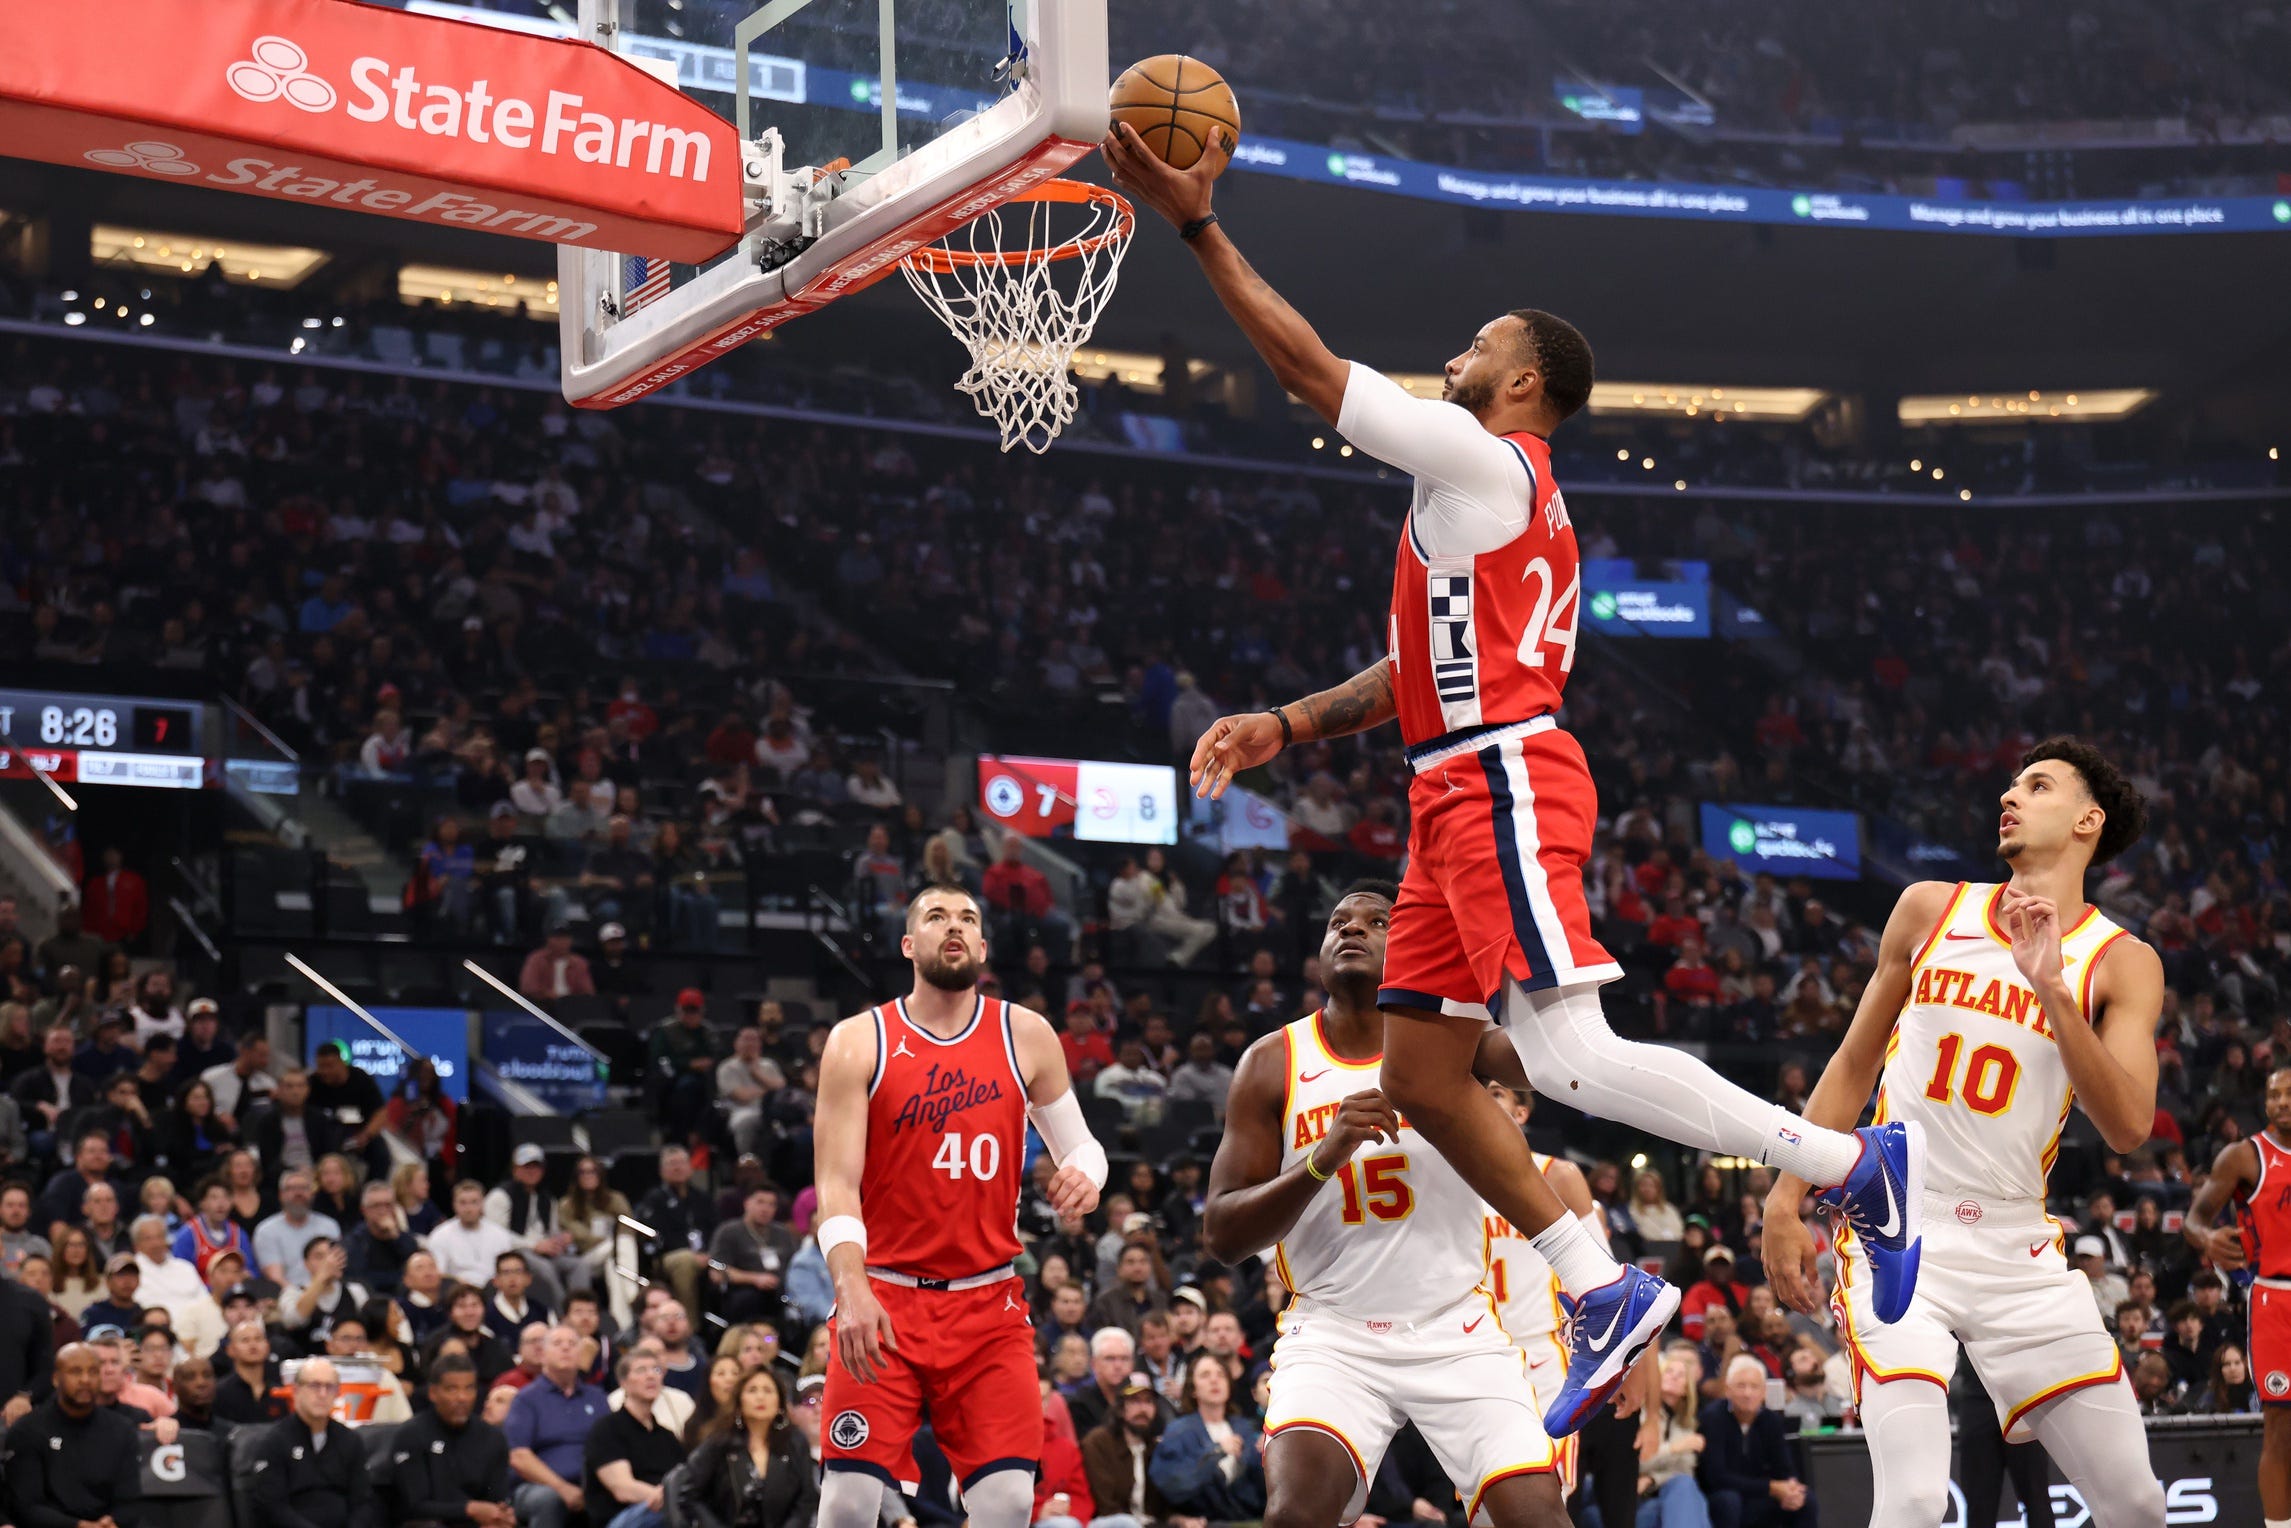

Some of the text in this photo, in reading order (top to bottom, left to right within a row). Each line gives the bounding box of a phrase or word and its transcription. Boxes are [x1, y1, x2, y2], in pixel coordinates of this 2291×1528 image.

[948, 165, 1052, 220] HERDEZ SALSA
[826, 239, 920, 292] HERDEZ SALSA
[712, 325, 761, 348] HERDEZ
[648, 364, 690, 383] SALSA
[1516, 556, 1581, 673] 24
[41, 706, 118, 747] 8:26
[1914, 967, 2058, 1042] ATLANT
[924, 1063, 969, 1097] Los
[1925, 1030, 2023, 1118] 10
[893, 1077, 1004, 1134] Angeles
[932, 1132, 1001, 1181] 40
[1336, 1152, 1416, 1226] 15
[1955, 1206, 1983, 1218] HAWKS
[1366, 1320, 1393, 1330] HAWKS
[150, 1444, 186, 1482] G
